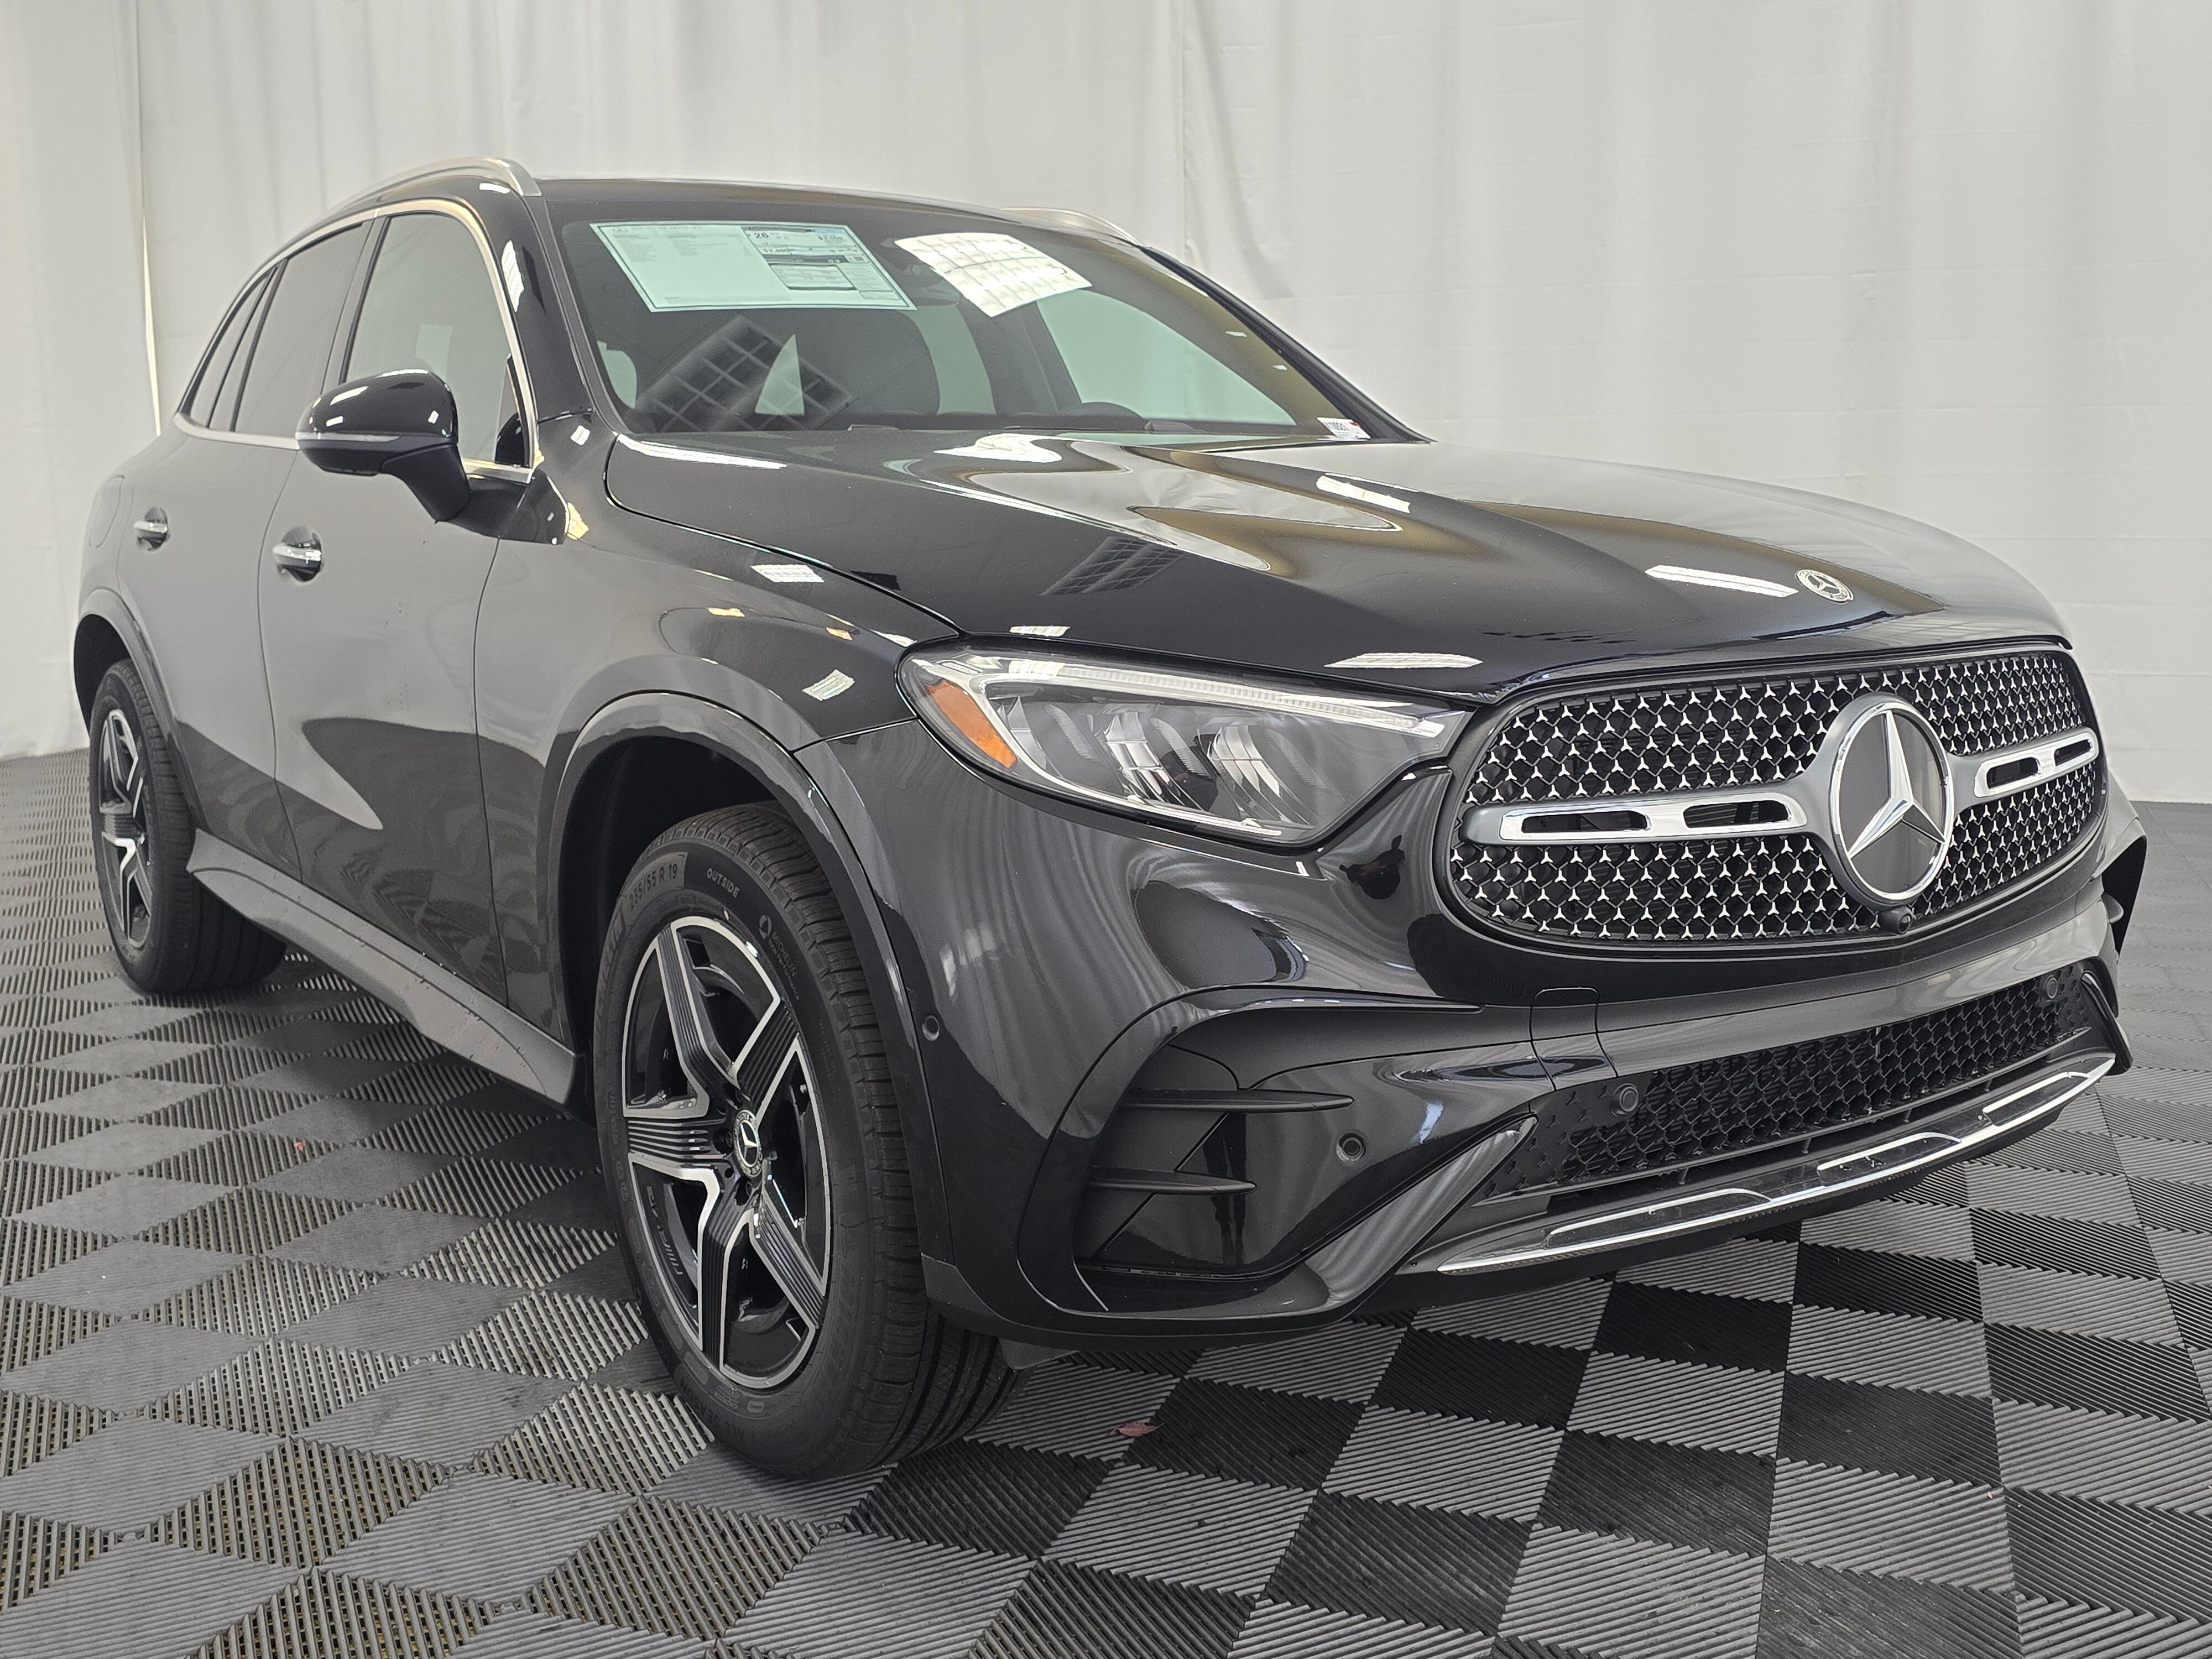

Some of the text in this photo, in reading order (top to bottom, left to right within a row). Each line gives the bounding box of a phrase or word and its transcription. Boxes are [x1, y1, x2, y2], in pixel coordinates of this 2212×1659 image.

[659, 866, 665, 883] R
[669, 863, 678, 880] 19
[707, 868, 740, 898] OUTSIDE
[772, 931, 797, 977] MICHELIN
